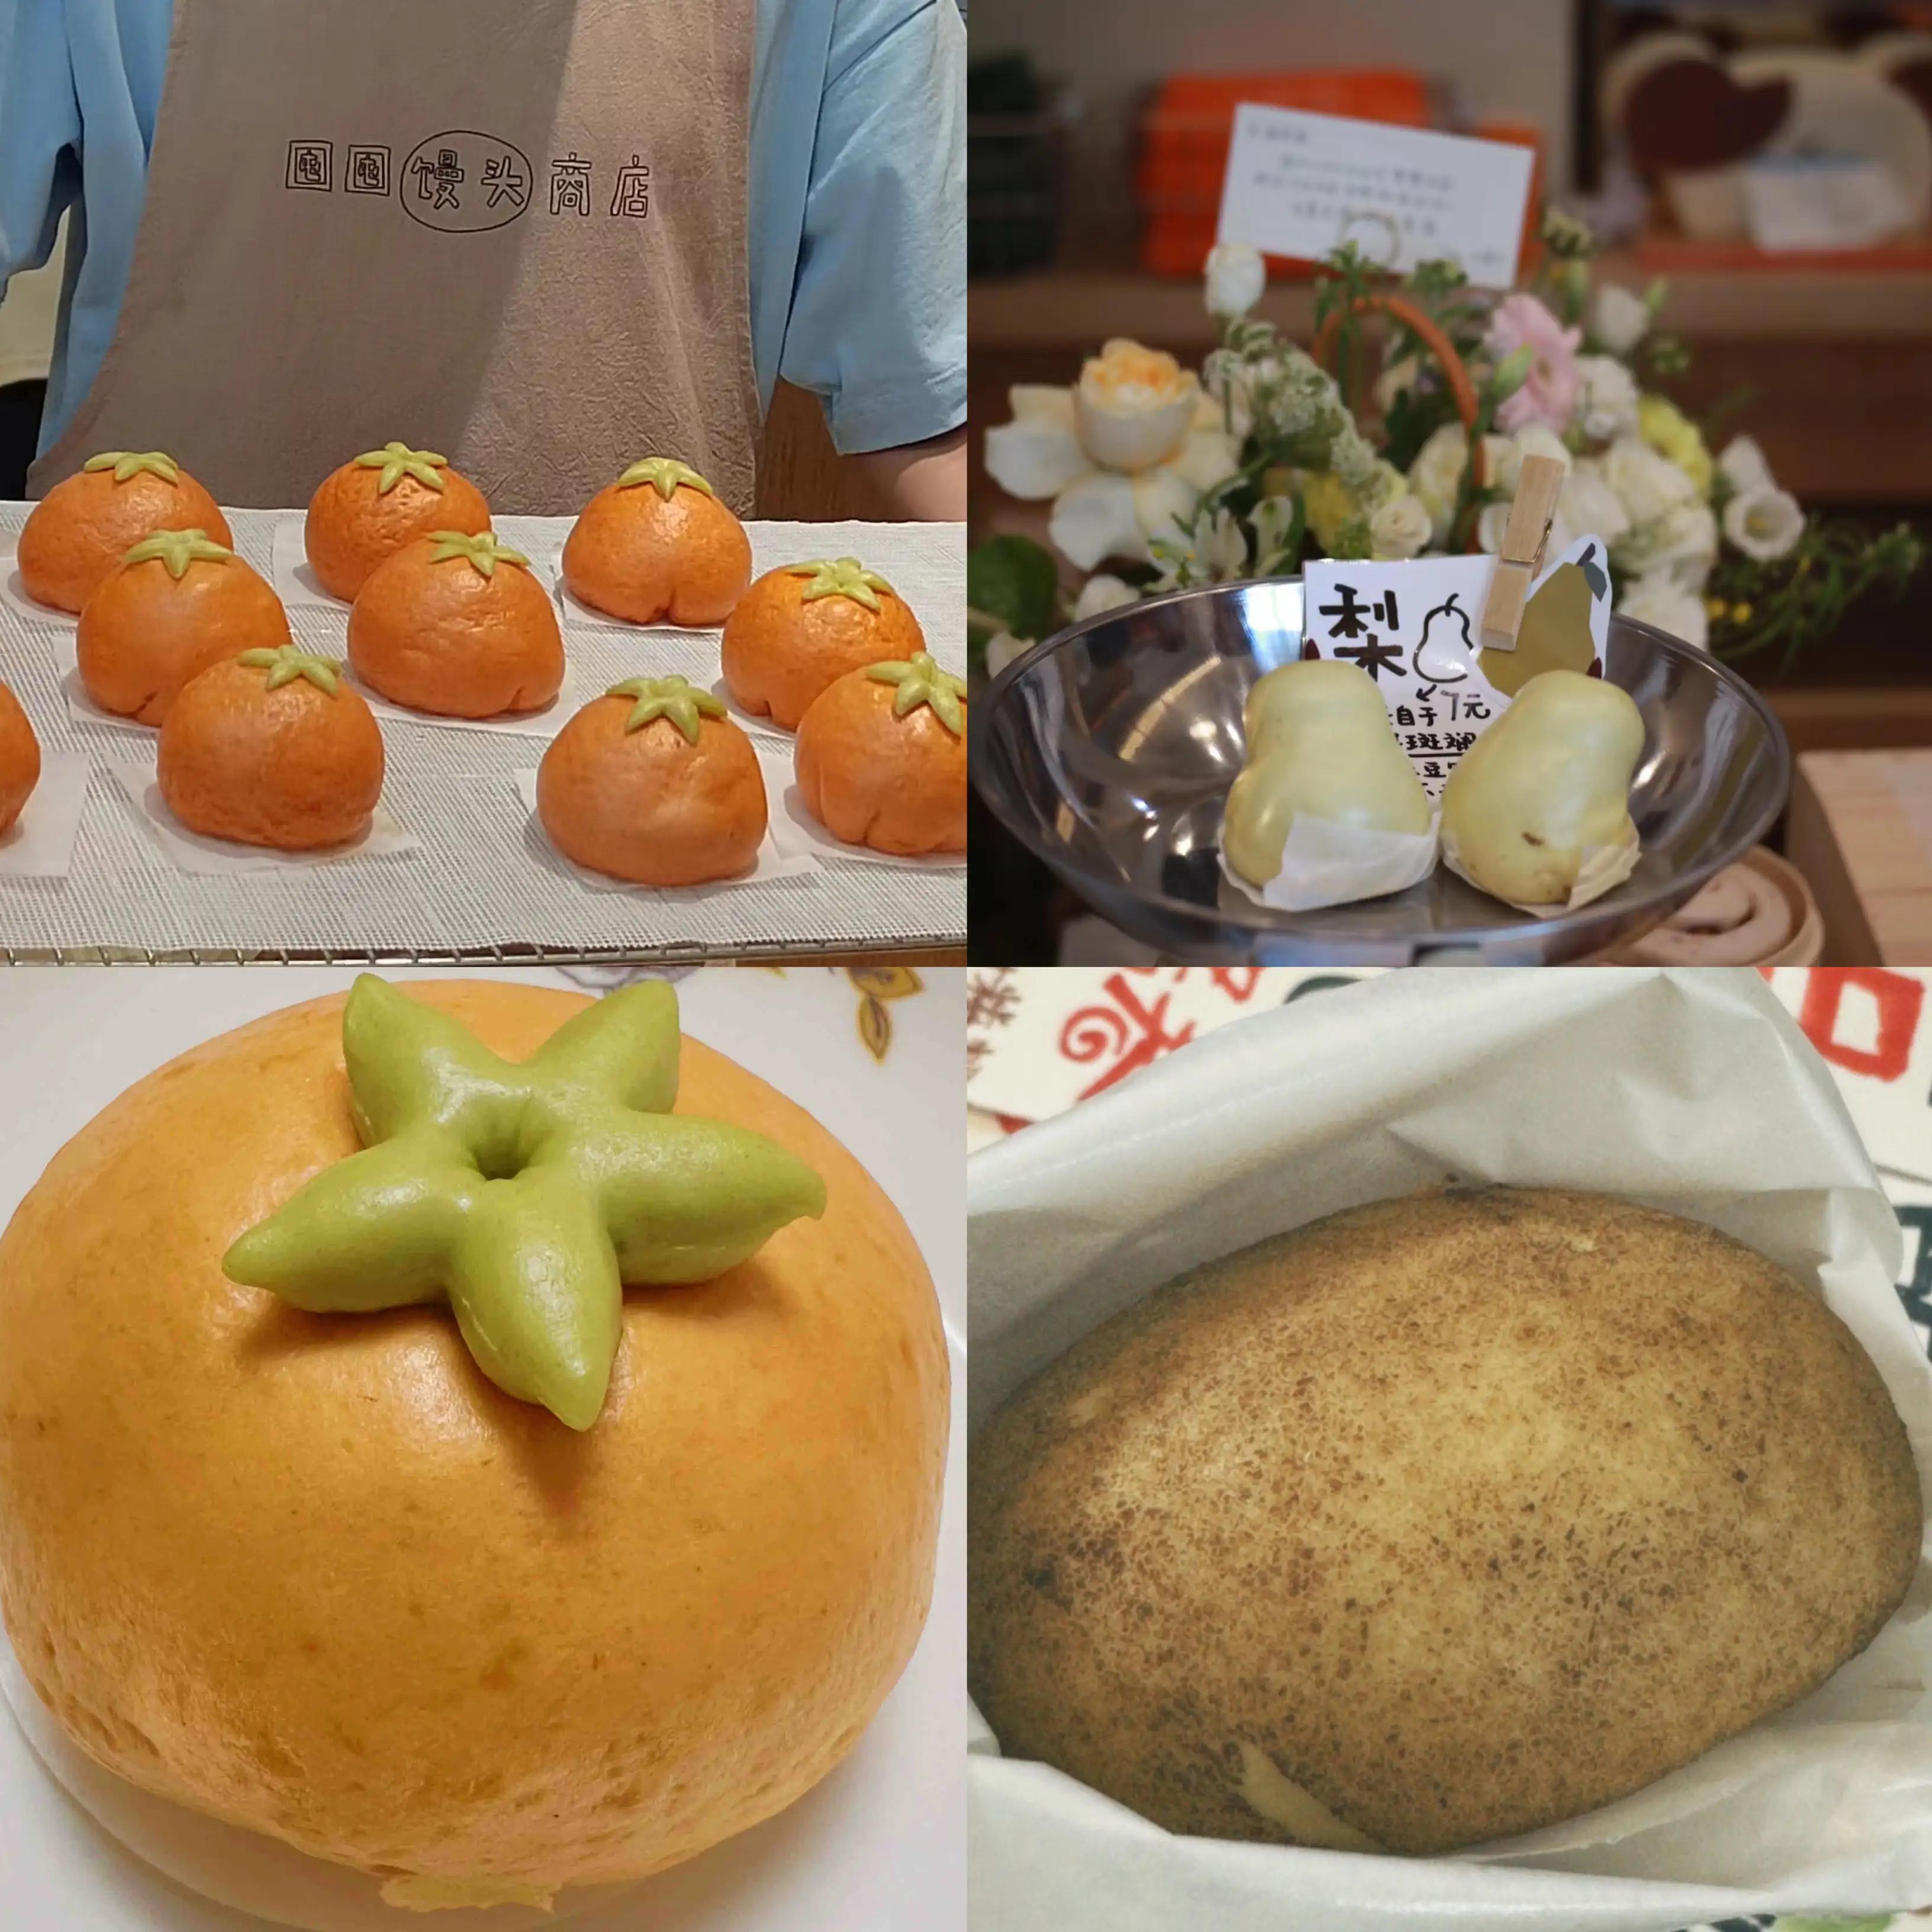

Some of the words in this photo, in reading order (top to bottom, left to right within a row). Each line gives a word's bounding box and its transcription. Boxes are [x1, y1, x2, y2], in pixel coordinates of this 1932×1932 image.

[1319, 584, 1407, 682] 梨
[1387, 704, 1438, 727] 自于
[1394, 732, 1477, 751] 斑斓
